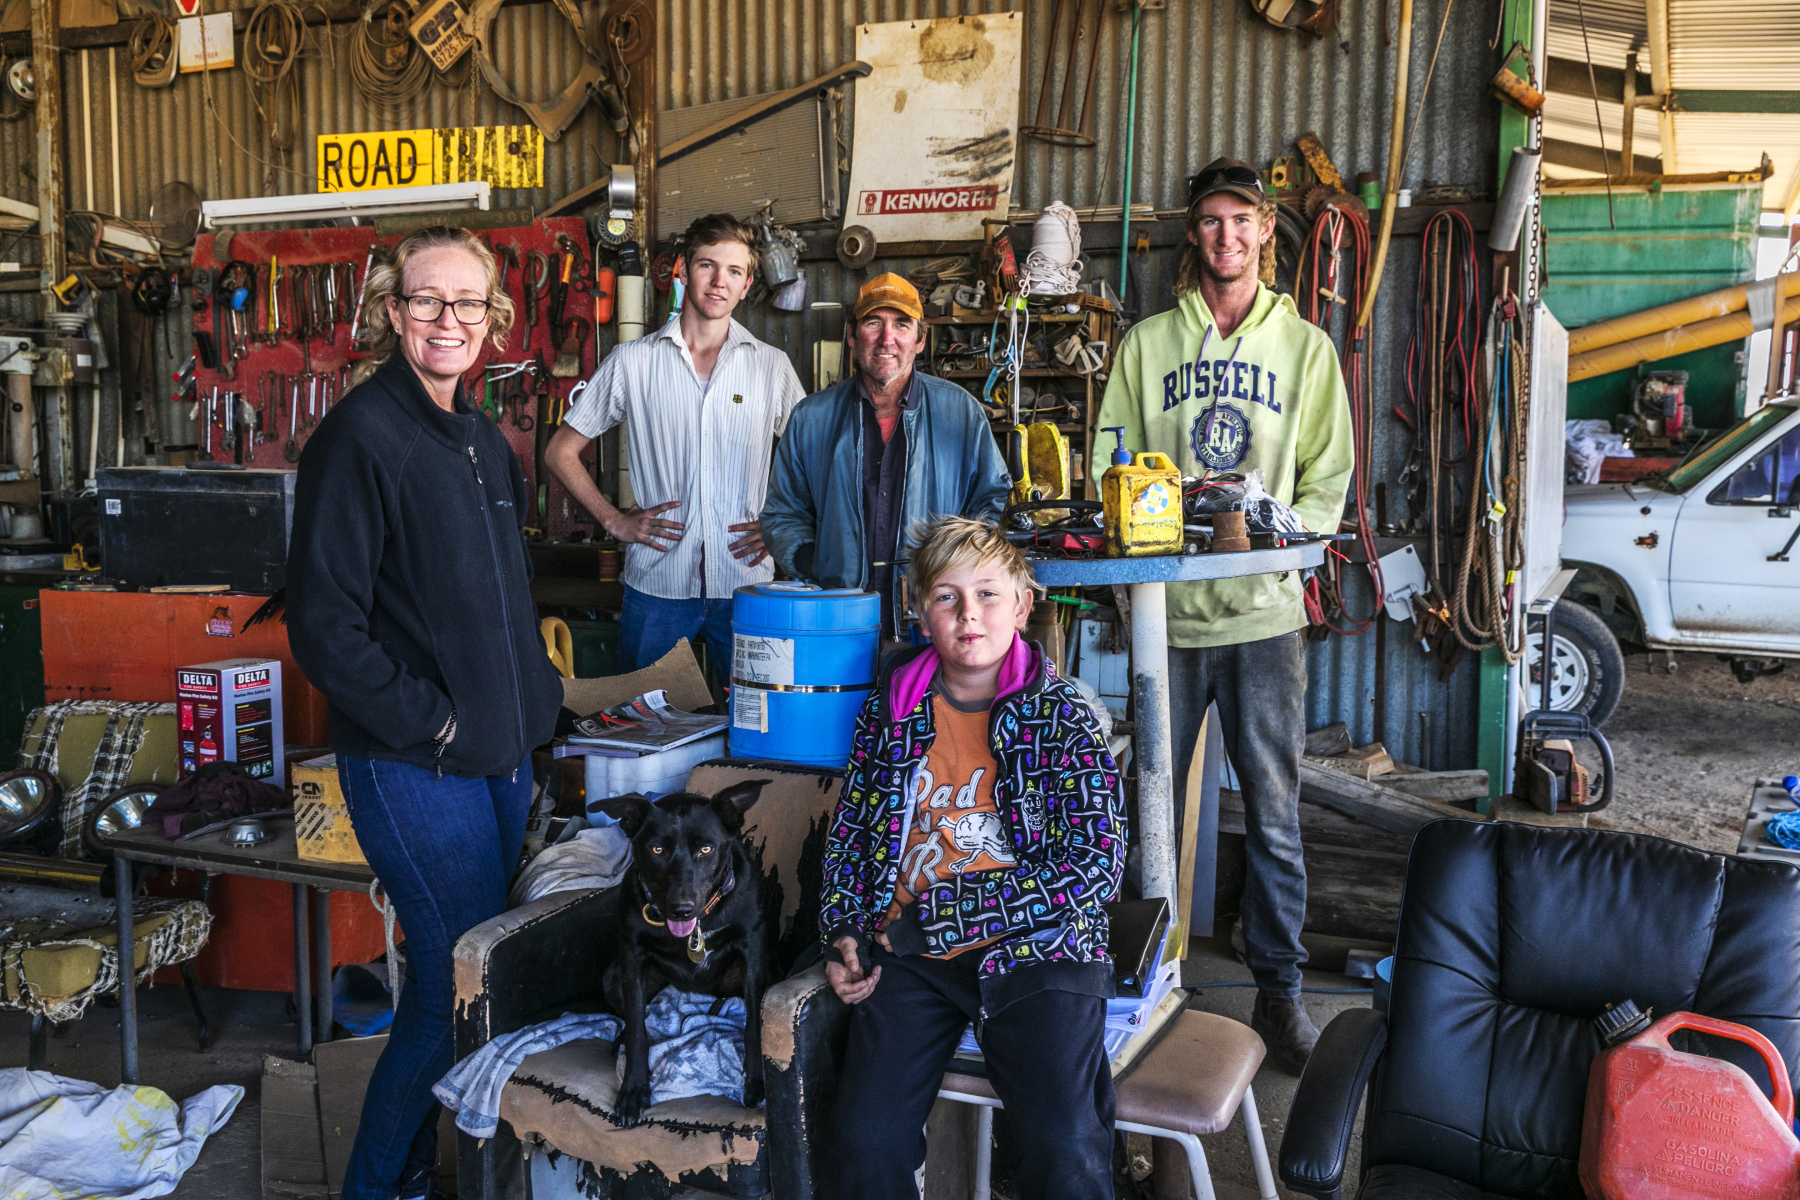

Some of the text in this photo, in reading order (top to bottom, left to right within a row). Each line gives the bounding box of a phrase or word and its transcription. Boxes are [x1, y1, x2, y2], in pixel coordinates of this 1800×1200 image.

[323, 137, 418, 189] ROAD
[438, 127, 543, 188] TRAIN
[885, 190, 993, 211] KENWORTH
[1163, 359, 1281, 415] RUSSELL
[183, 673, 213, 686] DELTA
[238, 670, 267, 684] DELTA
[306, 810, 319, 825] IVECO
[1671, 1087, 1742, 1112] ESSENCE
[1678, 1101, 1741, 1127] DANGER
[1670, 1115, 1738, 1139] INFLAMMABLE
[1665, 1138, 1741, 1166] GASOLINA
[1652, 1165, 1711, 1185] SUMAMENTE
[1672, 1153, 1734, 1177] PELIGRO
